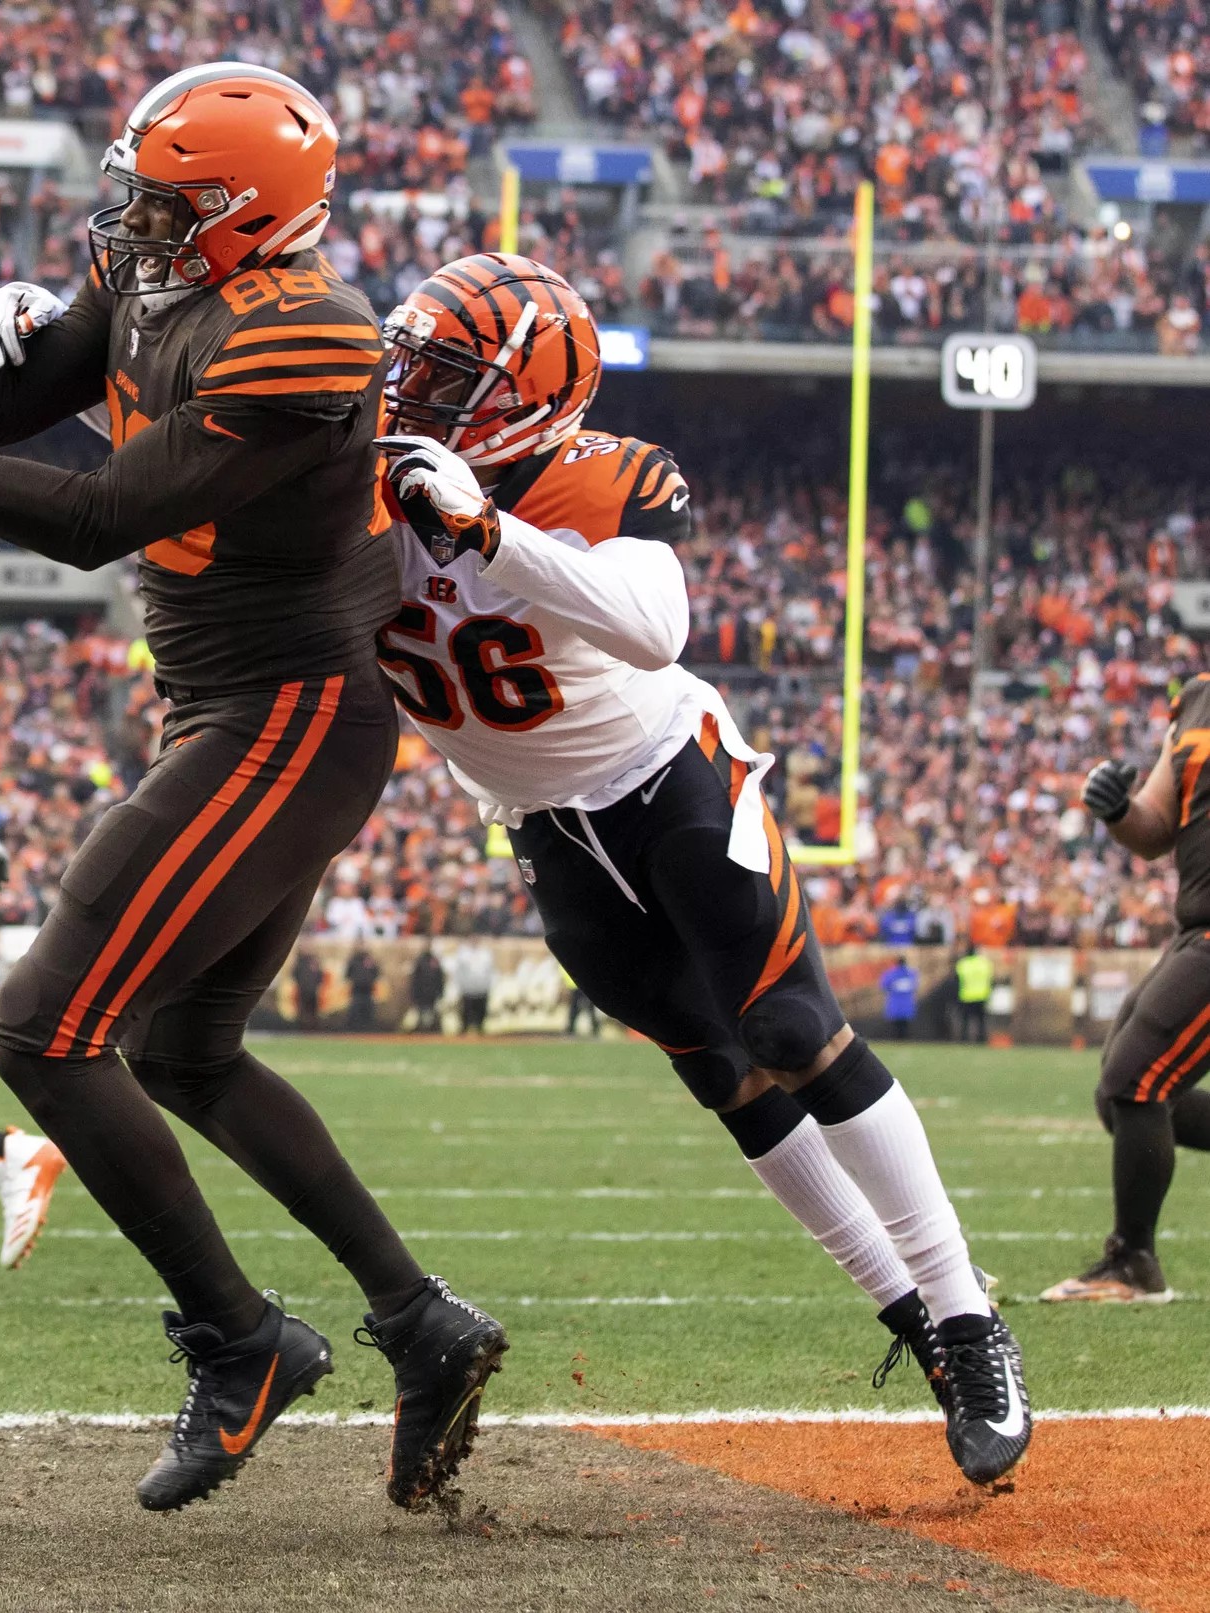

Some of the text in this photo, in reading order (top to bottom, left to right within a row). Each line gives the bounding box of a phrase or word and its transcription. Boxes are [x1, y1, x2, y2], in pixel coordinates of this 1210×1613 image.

[219, 267, 332, 316] 88
[956, 345, 1023, 400] 40
[375, 600, 565, 733] 56
